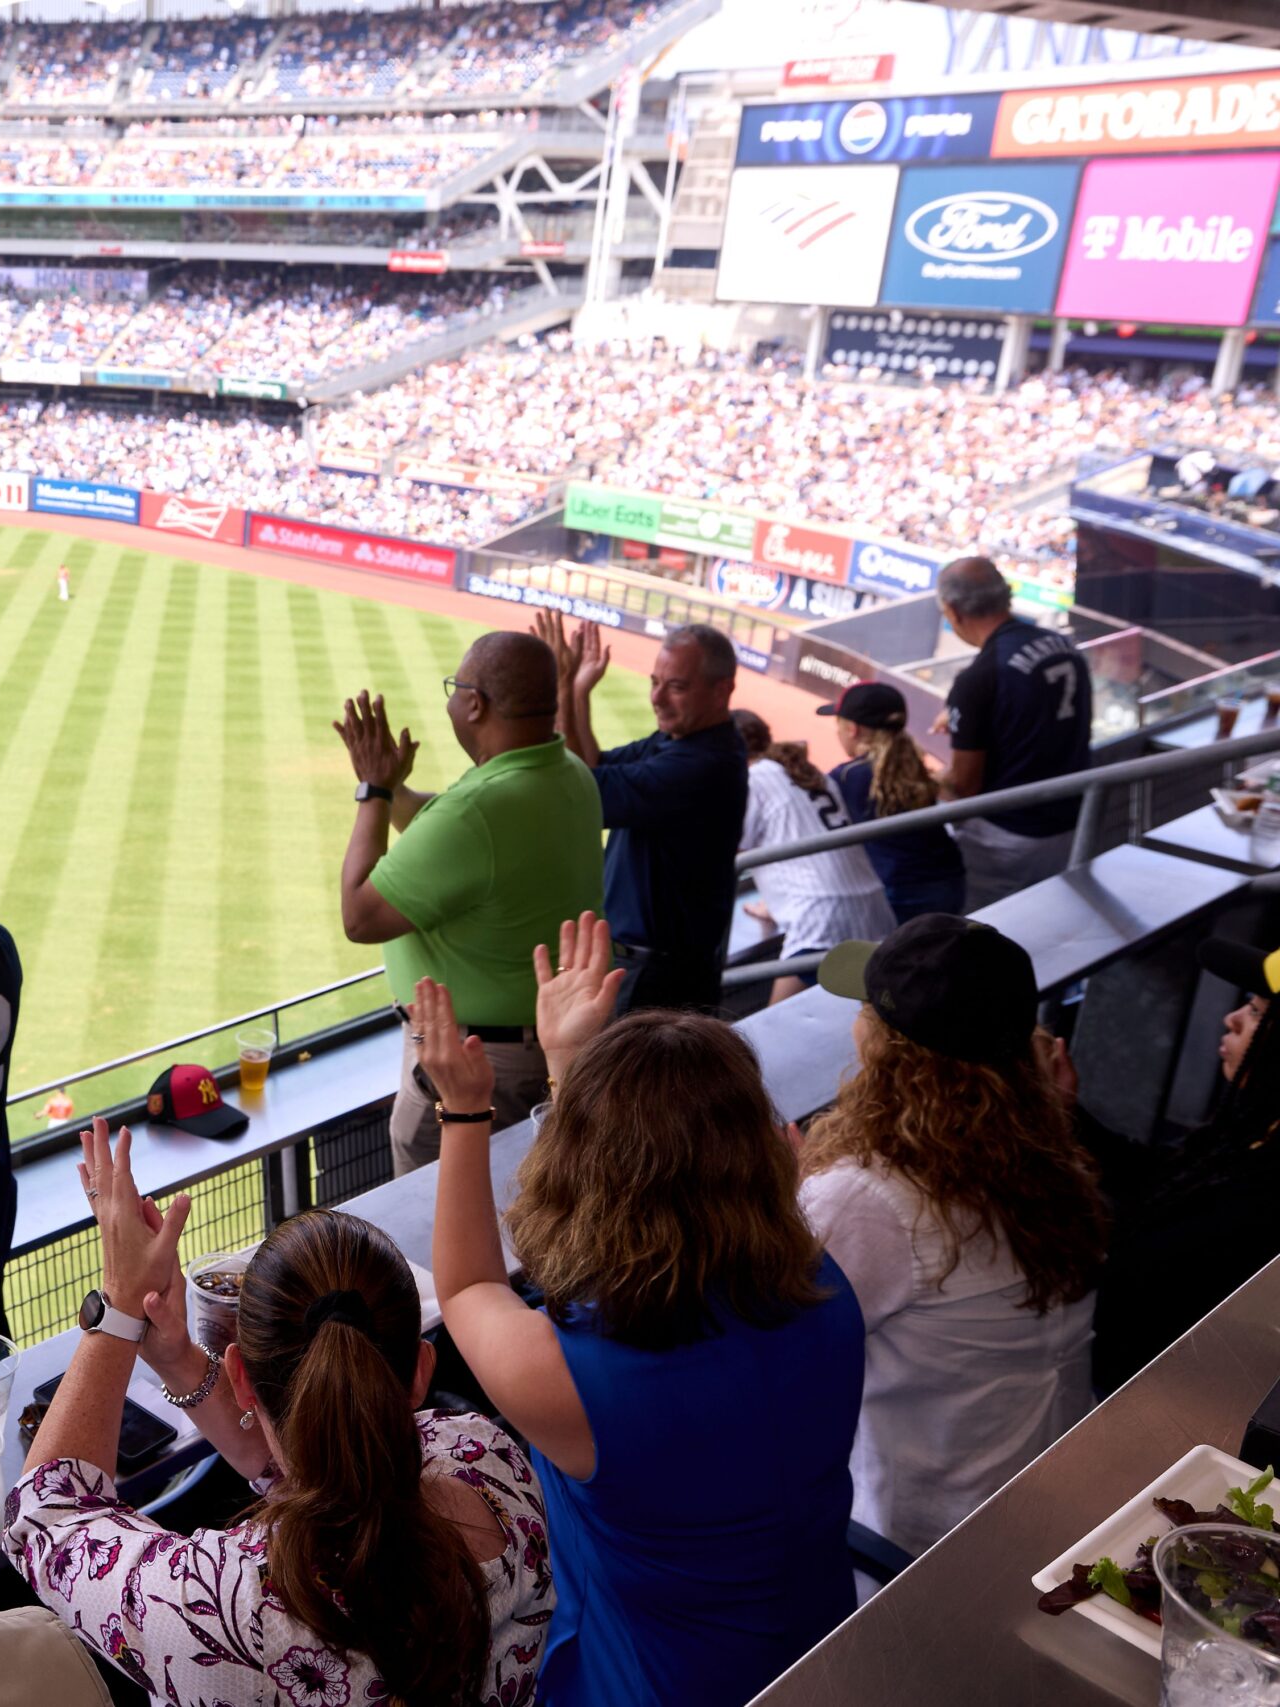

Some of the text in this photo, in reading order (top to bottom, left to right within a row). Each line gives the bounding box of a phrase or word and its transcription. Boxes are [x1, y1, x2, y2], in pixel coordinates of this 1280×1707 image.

[942, 8, 1207, 75] YANK
[1011, 79, 1280, 145] GATORADE
[928, 200, 1033, 250] Ford
[1118, 214, 1254, 263] Mobile
[573, 497, 611, 519] Uber
[615, 504, 655, 528] Eats
[1044, 660, 1078, 721] 7
